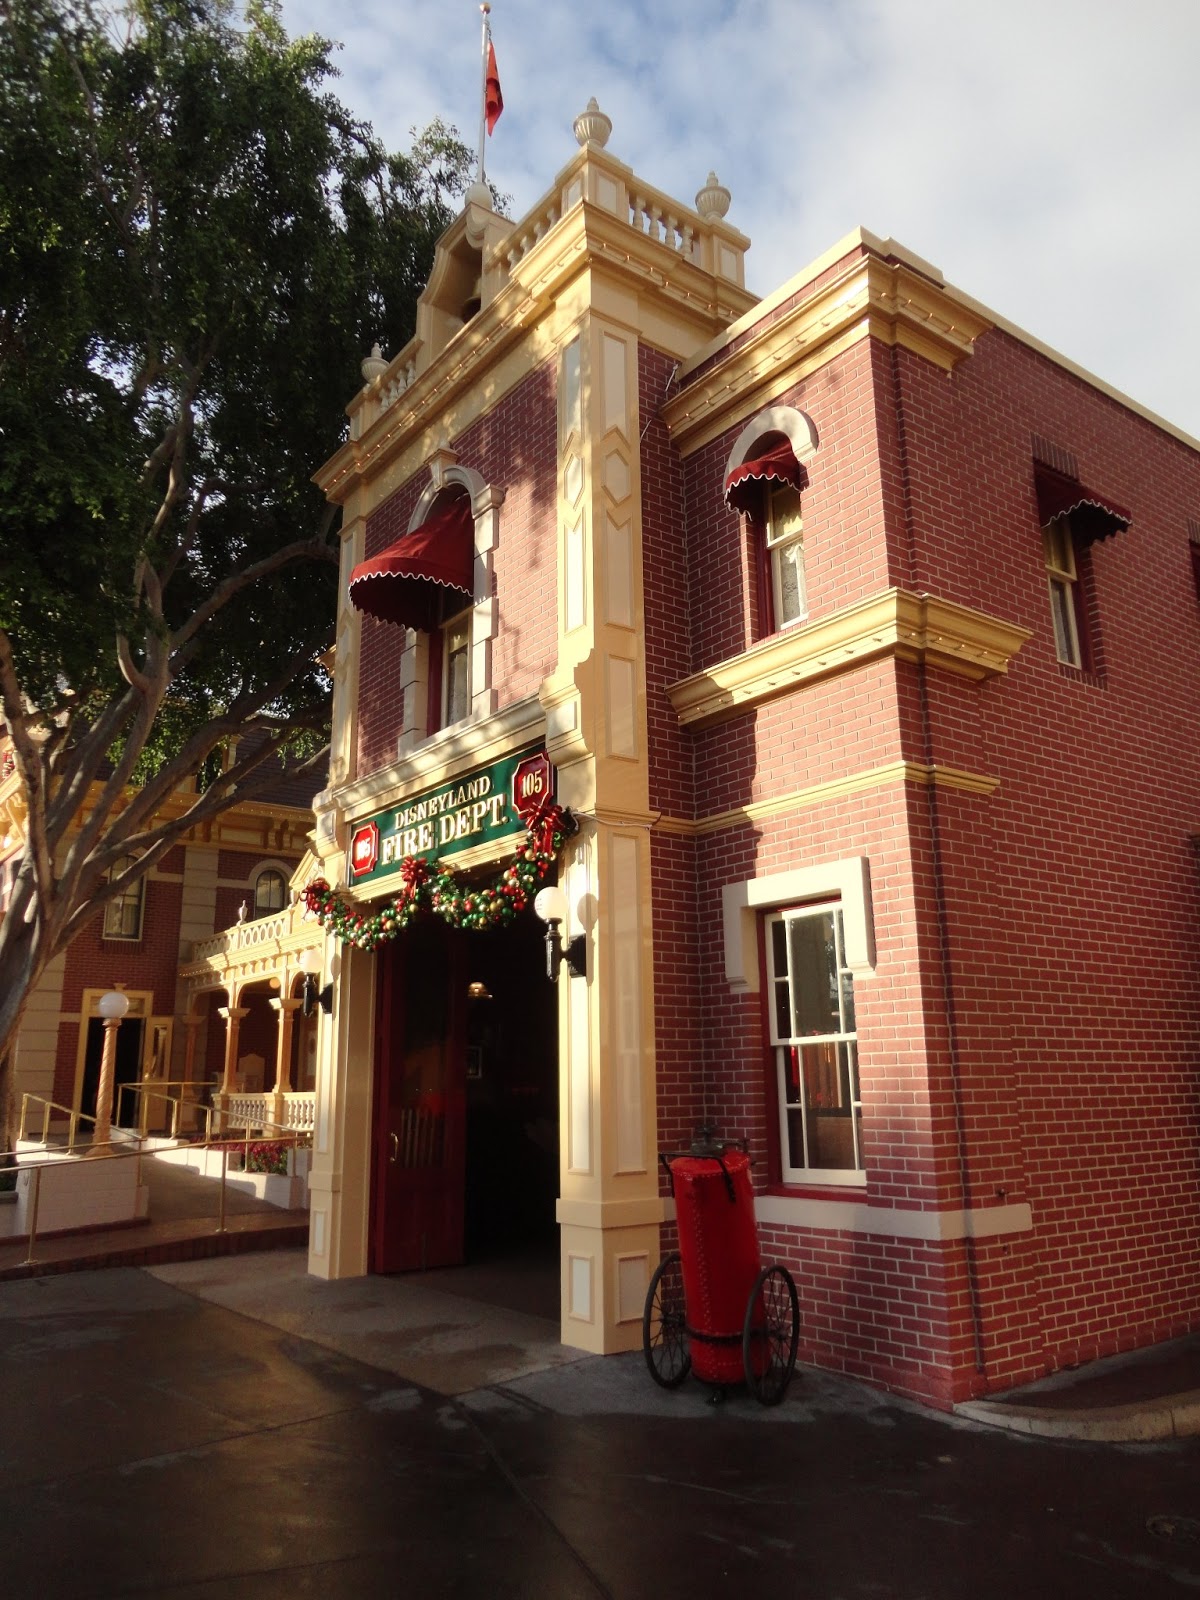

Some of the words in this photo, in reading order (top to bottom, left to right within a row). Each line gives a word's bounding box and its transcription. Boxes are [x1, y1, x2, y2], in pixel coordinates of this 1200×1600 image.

[395, 776, 491, 830] DISNEYLAND
[522, 769, 543, 799] 105
[381, 821, 434, 865] FIRE
[440, 793, 508, 845] DEPT.
